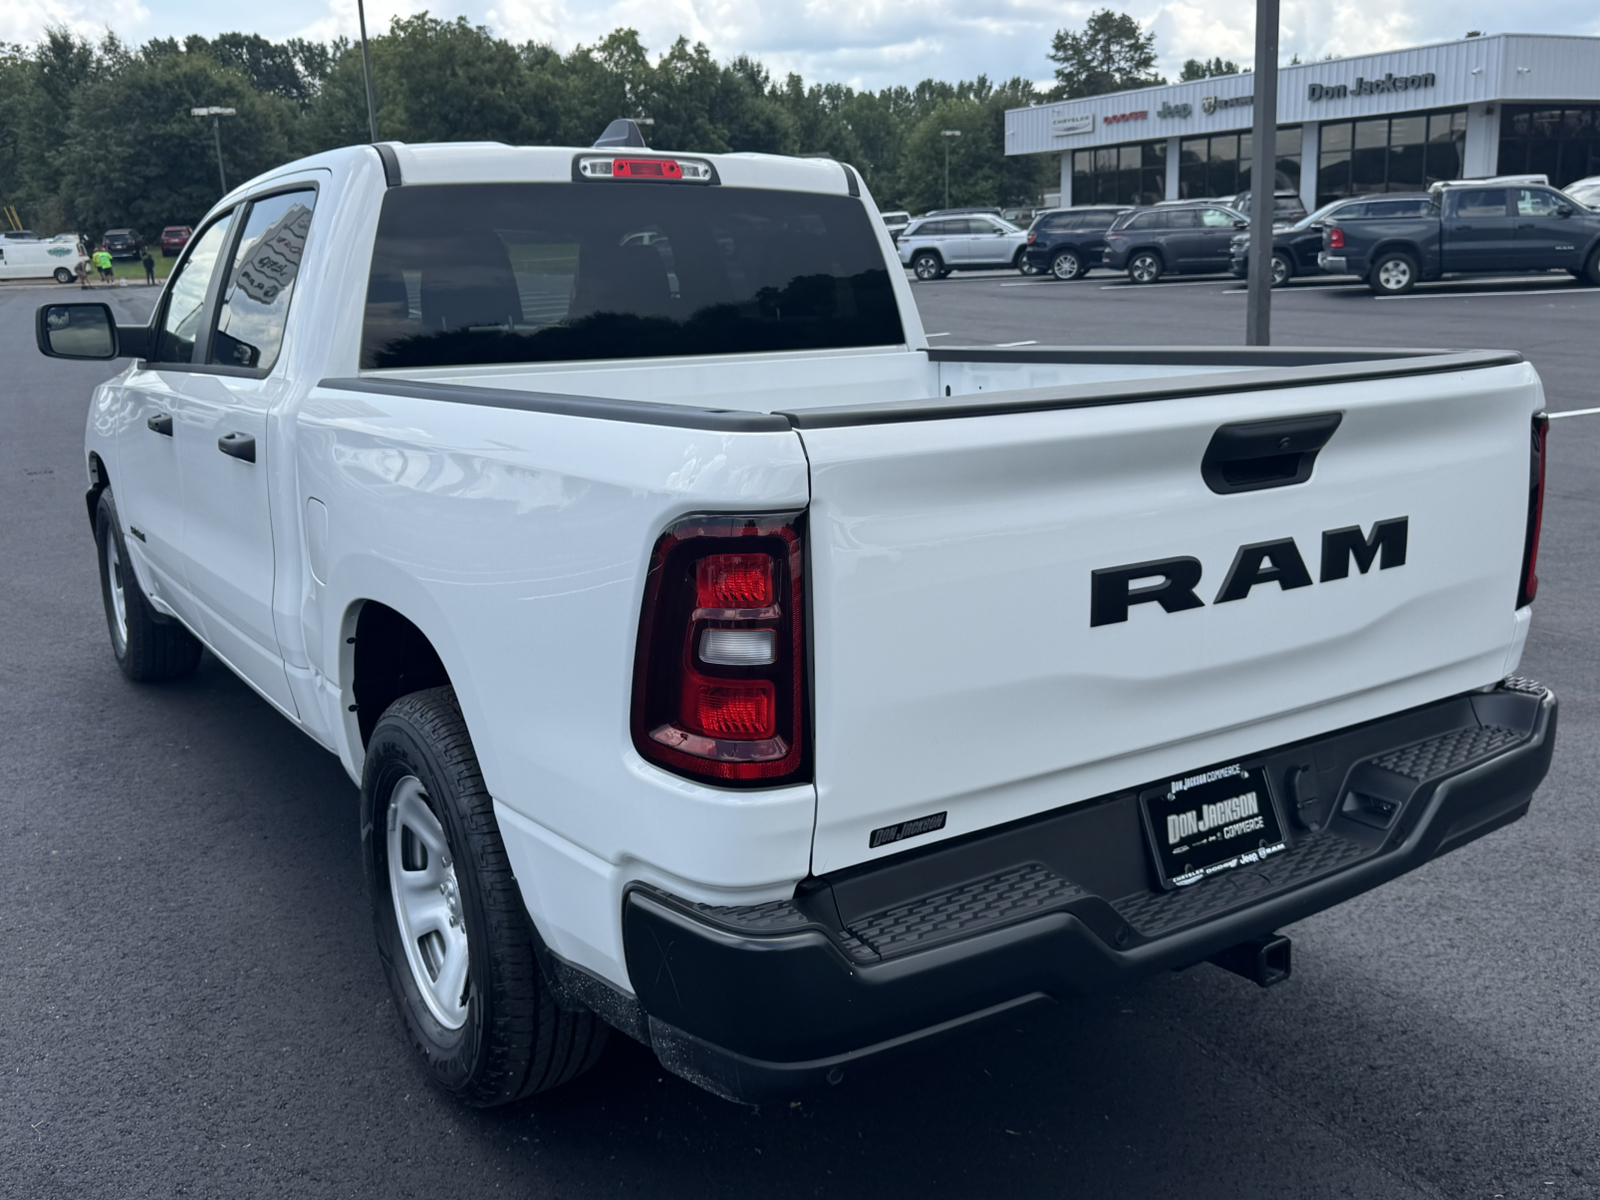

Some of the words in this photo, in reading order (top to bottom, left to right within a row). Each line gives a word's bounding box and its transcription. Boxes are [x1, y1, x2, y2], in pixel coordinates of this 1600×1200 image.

[1308, 83, 1347, 102] Don
[1349, 73, 1436, 97] Jackson
[1103, 110, 1148, 126] DODGE
[1156, 101, 1193, 120] Jeep
[1090, 515, 1409, 628] RAM
[1206, 763, 1241, 783] COMMERCE
[873, 827, 898, 847] DON
[896, 813, 945, 841] JACKSON
[1167, 810, 1198, 845] DON
[1198, 791, 1259, 832] JACKSON
[1223, 815, 1265, 839] COMMERCE
[1265, 843, 1286, 855] RAM
